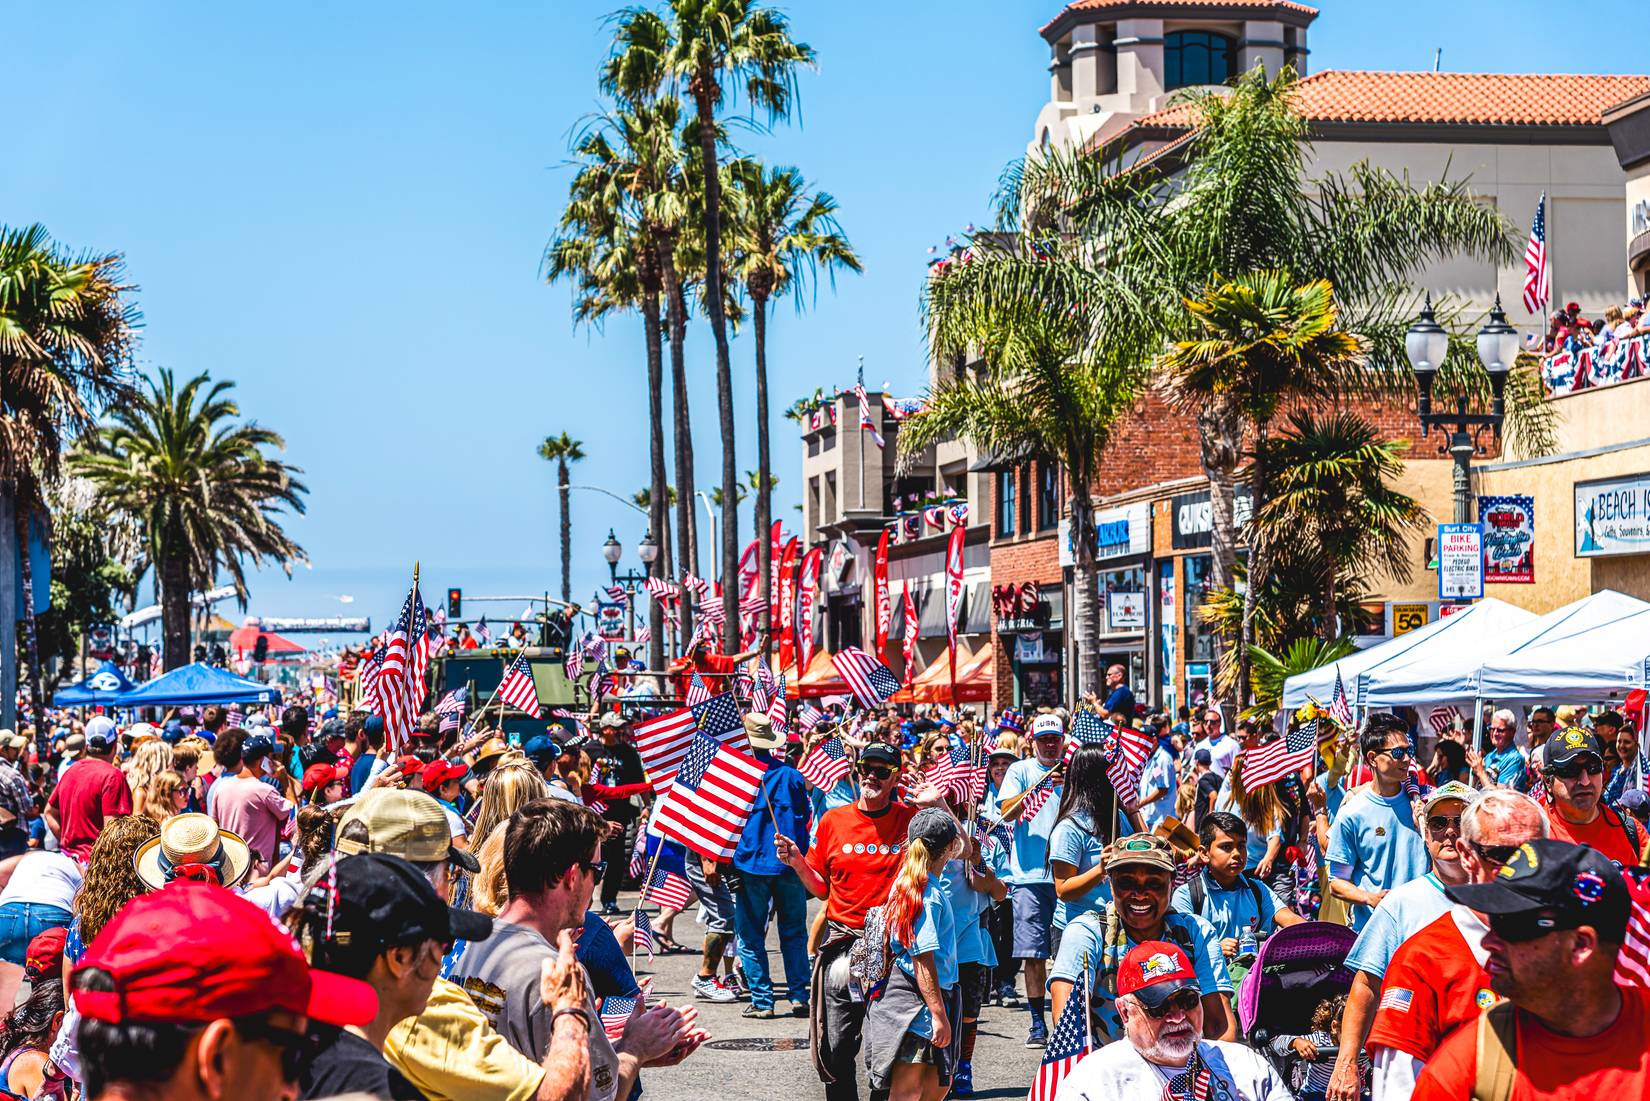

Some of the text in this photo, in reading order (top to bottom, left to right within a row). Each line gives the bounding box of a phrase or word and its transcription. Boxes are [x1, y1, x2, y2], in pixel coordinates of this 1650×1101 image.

[1598, 490, 1636, 521] BEACH
[1450, 535, 1472, 543] BIKE
[1462, 525, 1477, 534] City
[1443, 544, 1479, 552] PARKING
[782, 578, 792, 629] JACKS
[877, 577, 890, 634] JACKS
